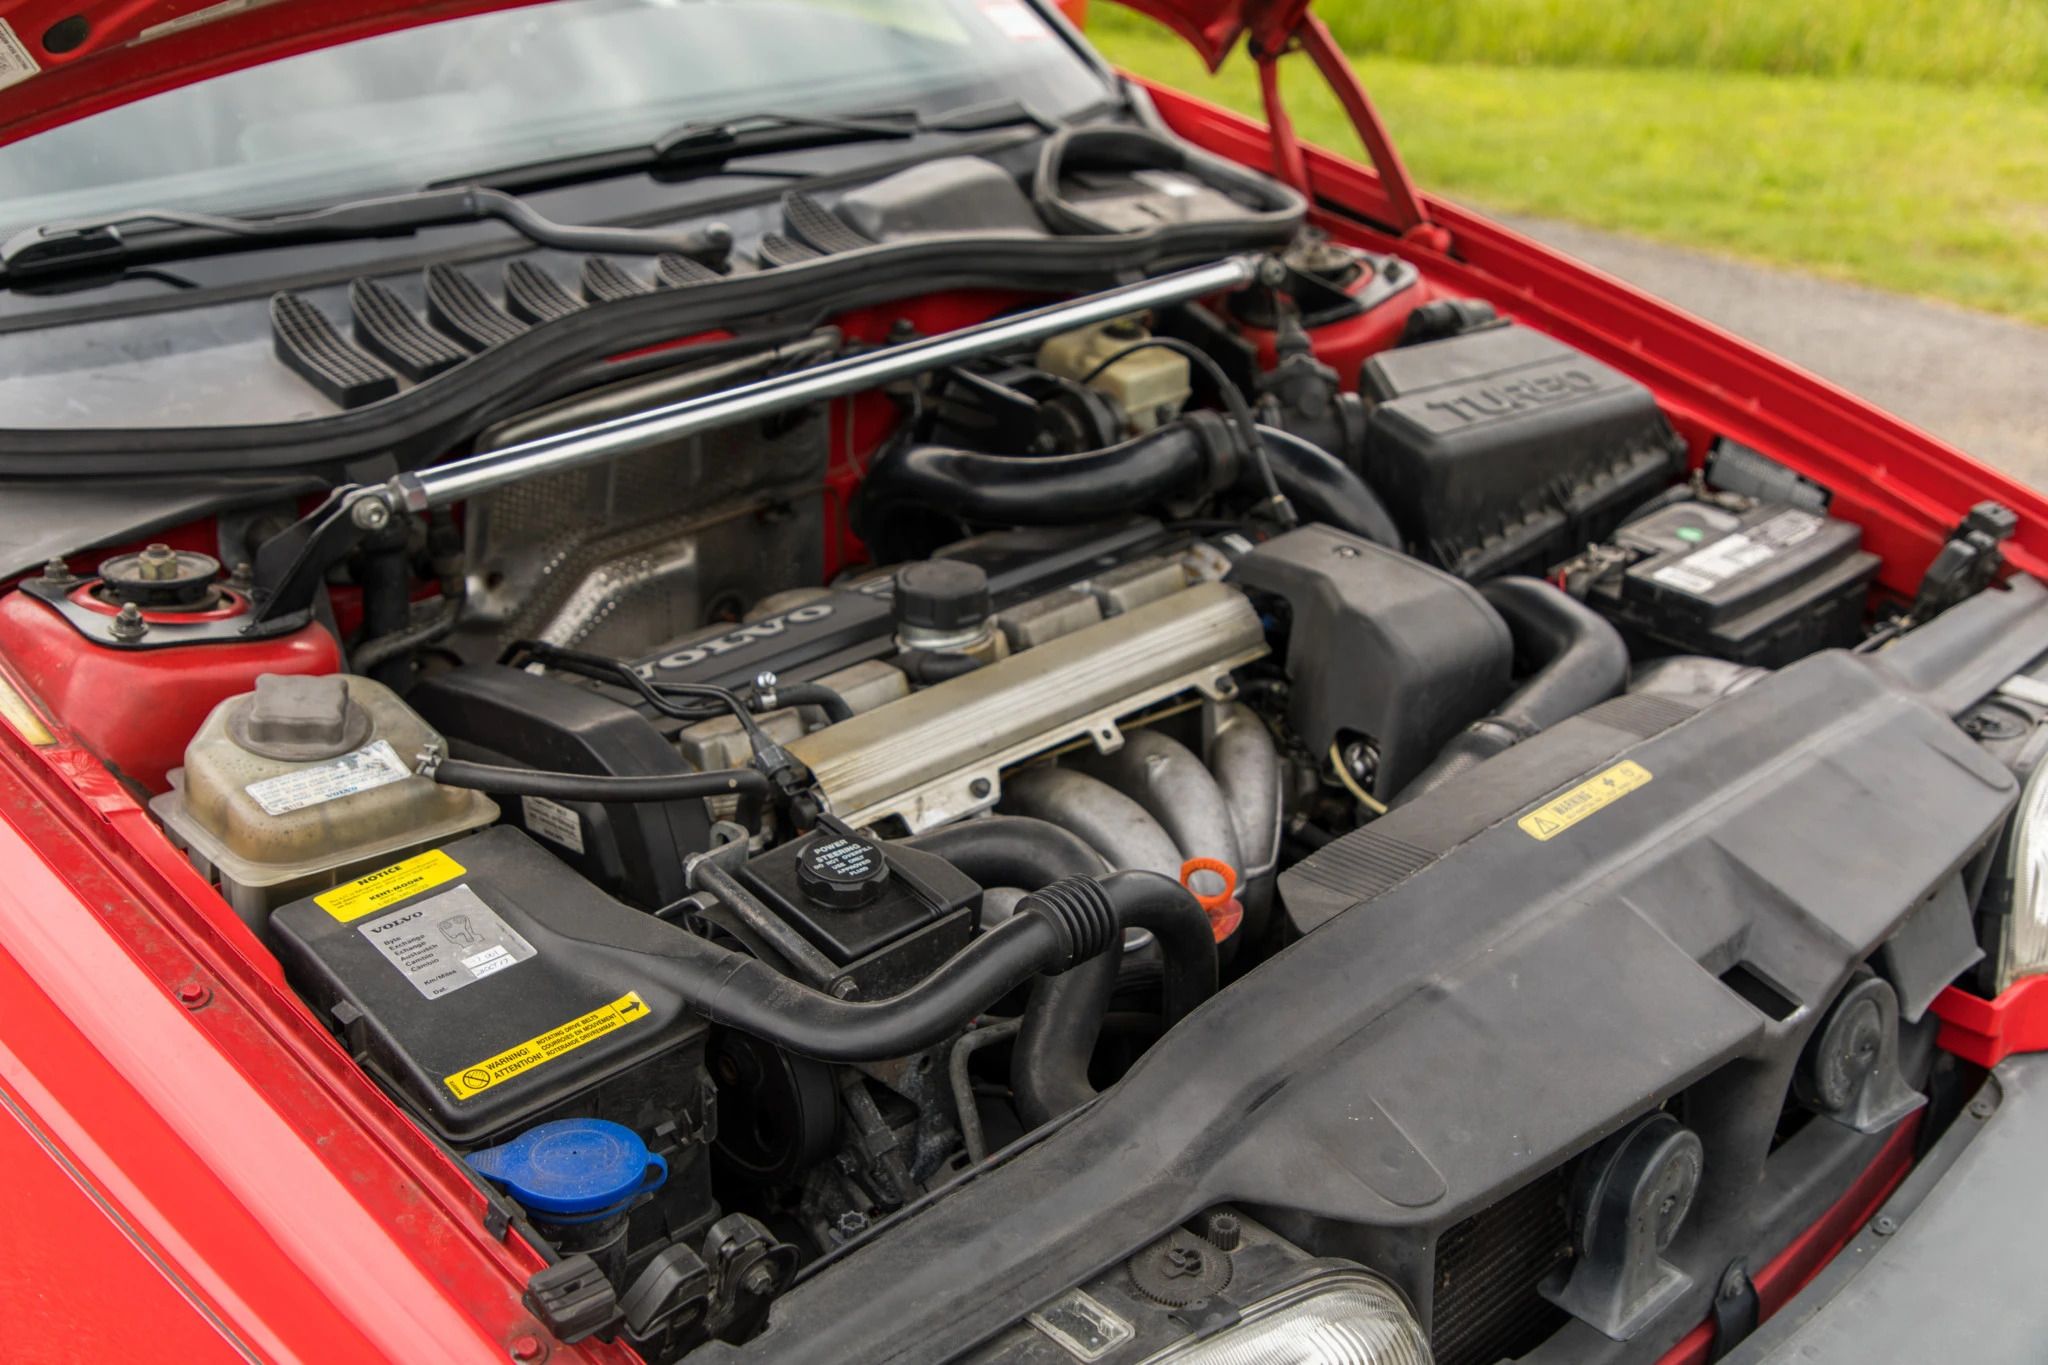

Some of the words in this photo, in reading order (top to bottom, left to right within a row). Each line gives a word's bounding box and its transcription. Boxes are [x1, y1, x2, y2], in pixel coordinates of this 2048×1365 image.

[1424, 369, 1600, 422] TURBO
[814, 839, 848, 855] POWER
[815, 843, 861, 863] STEERING
[825, 857, 839, 866] NOT
[841, 845, 873, 860] OVERFILL
[831, 862, 847, 870] USE
[847, 854, 865, 864] ONLY
[837, 858, 872, 875] APPROVED
[849, 866, 869, 876] FLUID
[357, 865, 403, 886] NOTICE
[368, 876, 425, 901] KENT-MOORE
[370, 911, 424, 934] VOLVO
[383, 936, 402, 947] Byte
[388, 934, 425, 951] Exchange
[400, 943, 439, 961] Austausch
[405, 953, 435, 967] Cambio
[410, 958, 440, 973] Cambio
[536, 1029, 565, 1046] ROTATING
[564, 1021, 582, 1033] DRIVE
[580, 1014, 599, 1025] BELTS
[541, 1033, 575, 1051] COURROIES
[582, 1012, 617, 1032] MOUVEMENT
[546, 1038, 580, 1057] ROTERANDE
[579, 1021, 617, 1041] DRIVREMMAR
[485, 1047, 530, 1071] WARNING!
[494, 1052, 543, 1079] ATTENTION!
